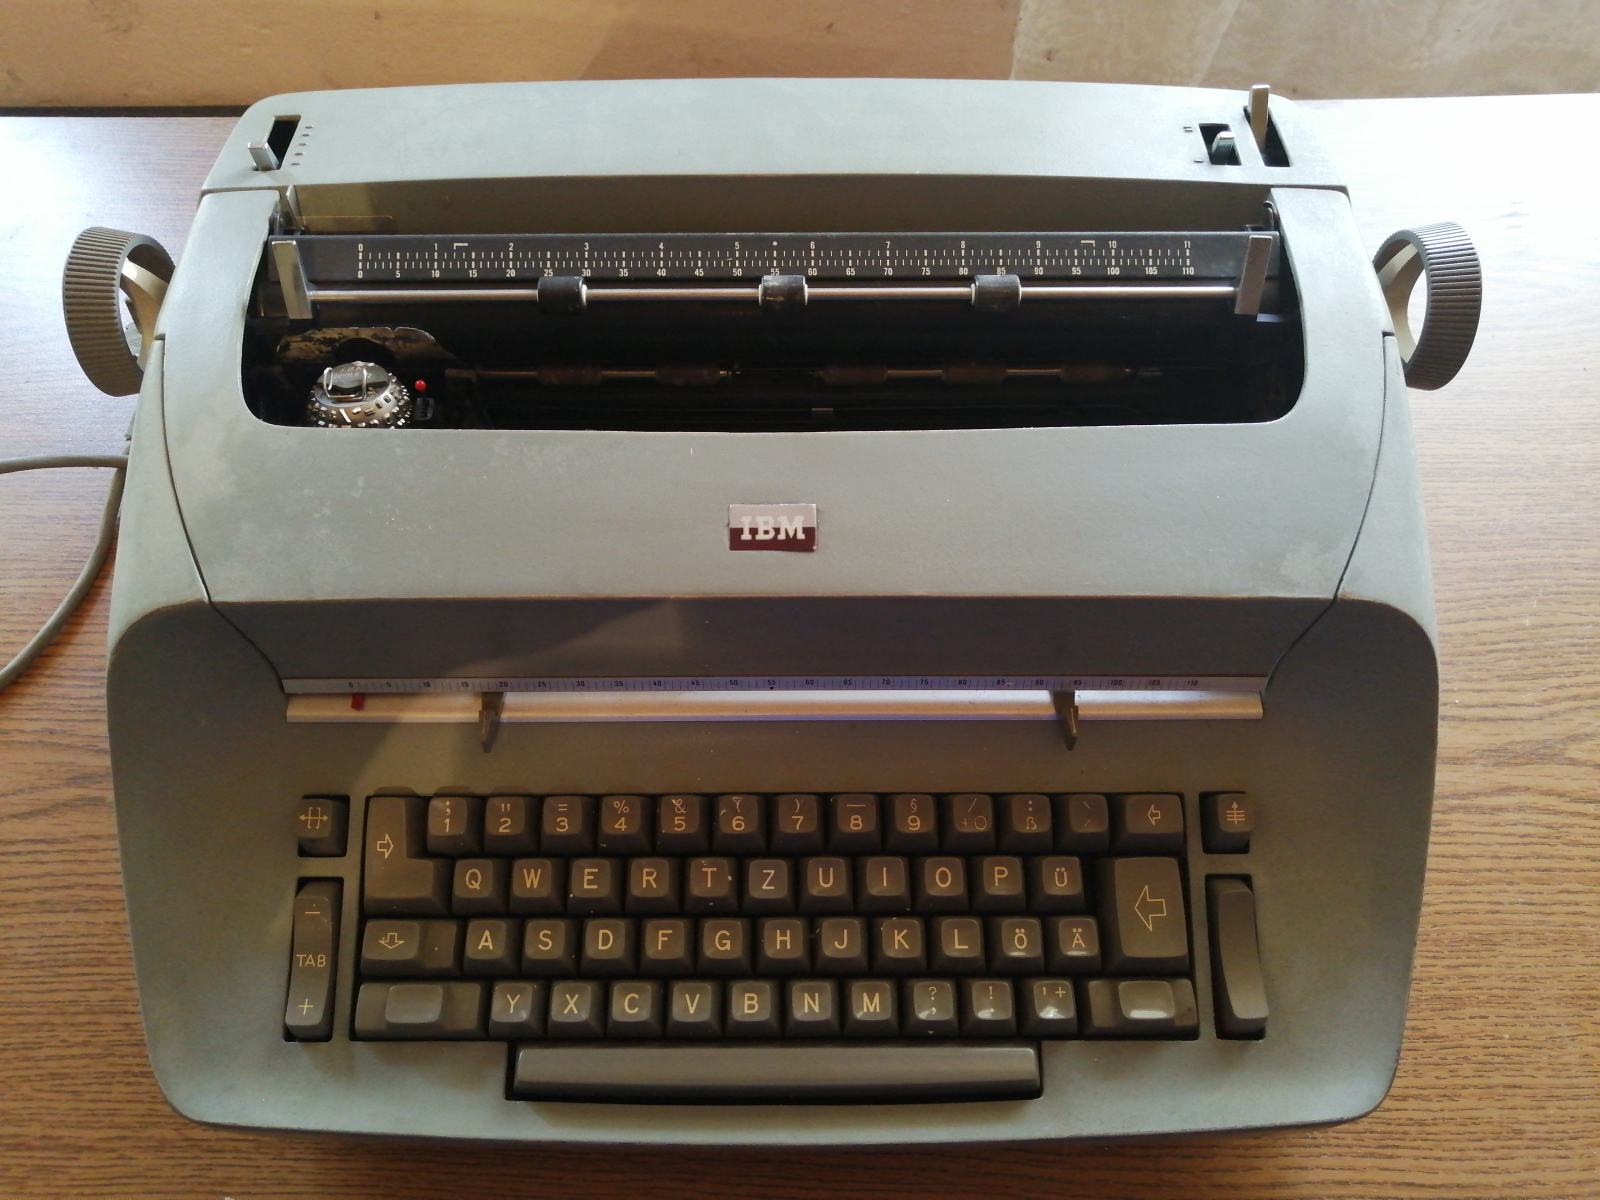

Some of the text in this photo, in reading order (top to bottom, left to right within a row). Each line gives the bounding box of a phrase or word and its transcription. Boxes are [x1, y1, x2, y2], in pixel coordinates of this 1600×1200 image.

[358, 240, 1191, 252] 0 1 2 3 4 5 6 7 8 9 10 11
[357, 267, 1195, 279] 0 5 10 15 20 25 30 35 40 45 50 55 60 65 70 75 80 85 90 95 100 105 110
[740, 515, 806, 540] IBM
[557, 803, 569, 812] =
[613, 800, 630, 814] %
[674, 798, 687, 814] &
[795, 798, 800, 813] )
[909, 798, 918, 813] §
[967, 798, 977, 813] /
[1028, 800, 1033, 812] :
[444, 818, 450, 833] 1
[498, 817, 511, 833] 2
[556, 817, 569, 832] 3
[614, 816, 628, 832] 4
[673, 816, 686, 831] 5
[731, 815, 745, 831] 6
[791, 815, 804, 831] 7
[850, 814, 863, 830] 8
[907, 815, 921, 831] 9
[465, 868, 482, 890] Q
[523, 868, 542, 889] W
[583, 868, 599, 889] E
[642, 868, 657, 889] R
[701, 867, 717, 888] T
[761, 869, 776, 890] Z
[818, 867, 834, 888] U
[882, 867, 887, 887] I
[935, 867, 952, 888] O
[994, 866, 1009, 887] P
[1054, 867, 1068, 887] Ü
[478, 929, 493, 950] A
[538, 929, 553, 951] S
[597, 929, 613, 950] D
[657, 929, 673, 950] F
[714, 929, 731, 951] G
[776, 929, 791, 950] H
[834, 929, 848, 950] J
[894, 929, 910, 950] K
[954, 928, 969, 949] L
[1014, 928, 1028, 949] Ö
[1071, 927, 1086, 949] Ä
[296, 954, 326, 968] TAB
[624, 992, 639, 1014] C
[804, 992, 819, 1013] N
[863, 992, 880, 1013] M
[928, 986, 937, 1000] ?
[989, 985, 993, 1000] !
[1055, 986, 1066, 999] +
[297, 998, 314, 1015] +
[506, 993, 520, 1014] Y
[563, 993, 579, 1014] X
[685, 993, 700, 1014] V
[743, 993, 759, 1014] B
